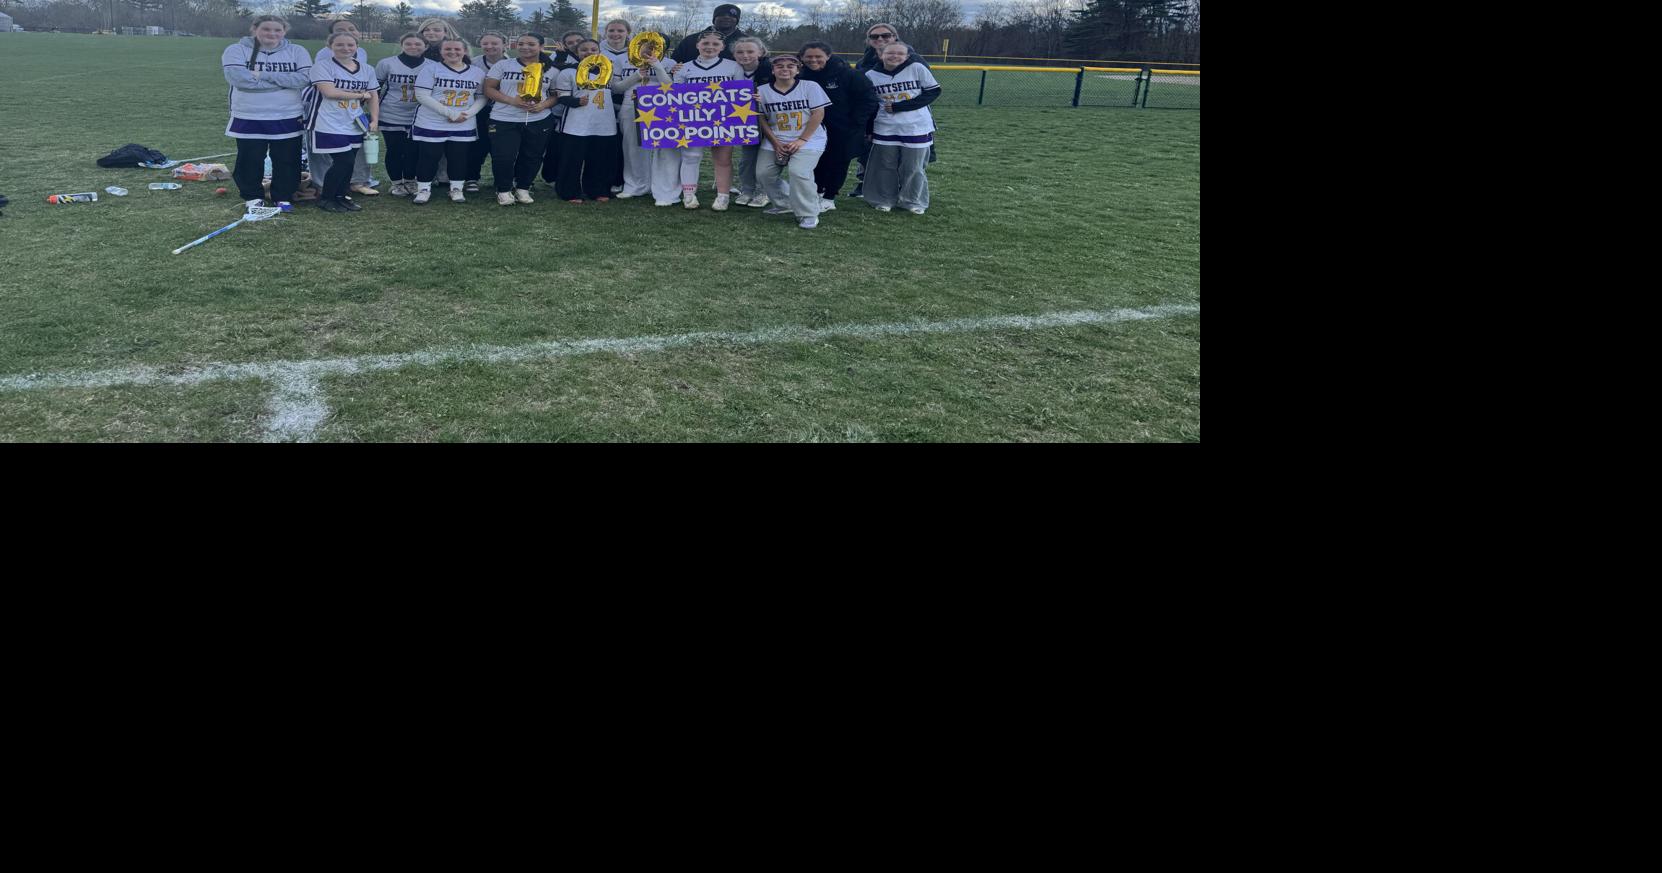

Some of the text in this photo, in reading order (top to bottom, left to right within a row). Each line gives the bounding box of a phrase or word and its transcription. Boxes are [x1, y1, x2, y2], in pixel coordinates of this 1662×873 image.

[638, 88, 753, 107] CONGRATS
[776, 111, 803, 131] 27
[643, 125, 760, 141] 100 POINTS
